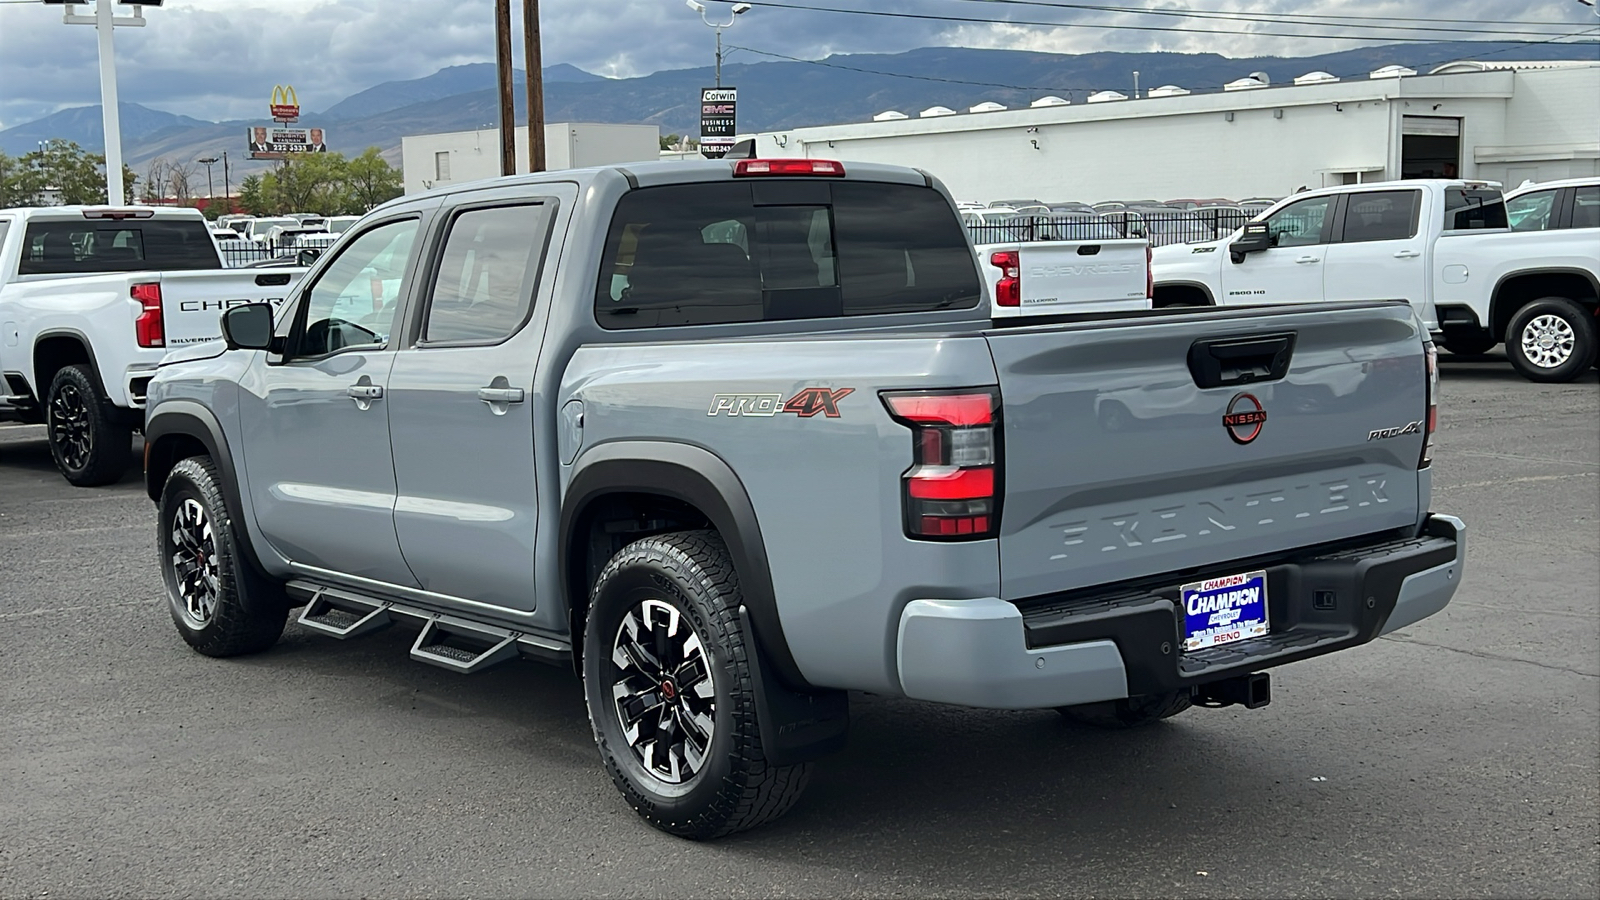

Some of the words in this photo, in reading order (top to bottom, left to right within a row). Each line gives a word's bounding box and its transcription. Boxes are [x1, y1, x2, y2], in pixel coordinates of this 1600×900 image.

[705, 91, 735, 100] Corwin
[703, 105, 734, 113] GMC
[1031, 263, 1140, 278] CHEVROLET
[707, 388, 856, 418] PRO-4X
[1225, 411, 1267, 425] NISSAN
[1204, 575, 1244, 590] CHAMPION
[1210, 610, 1239, 622] CHEVROLET
[1213, 631, 1241, 643] RENO
